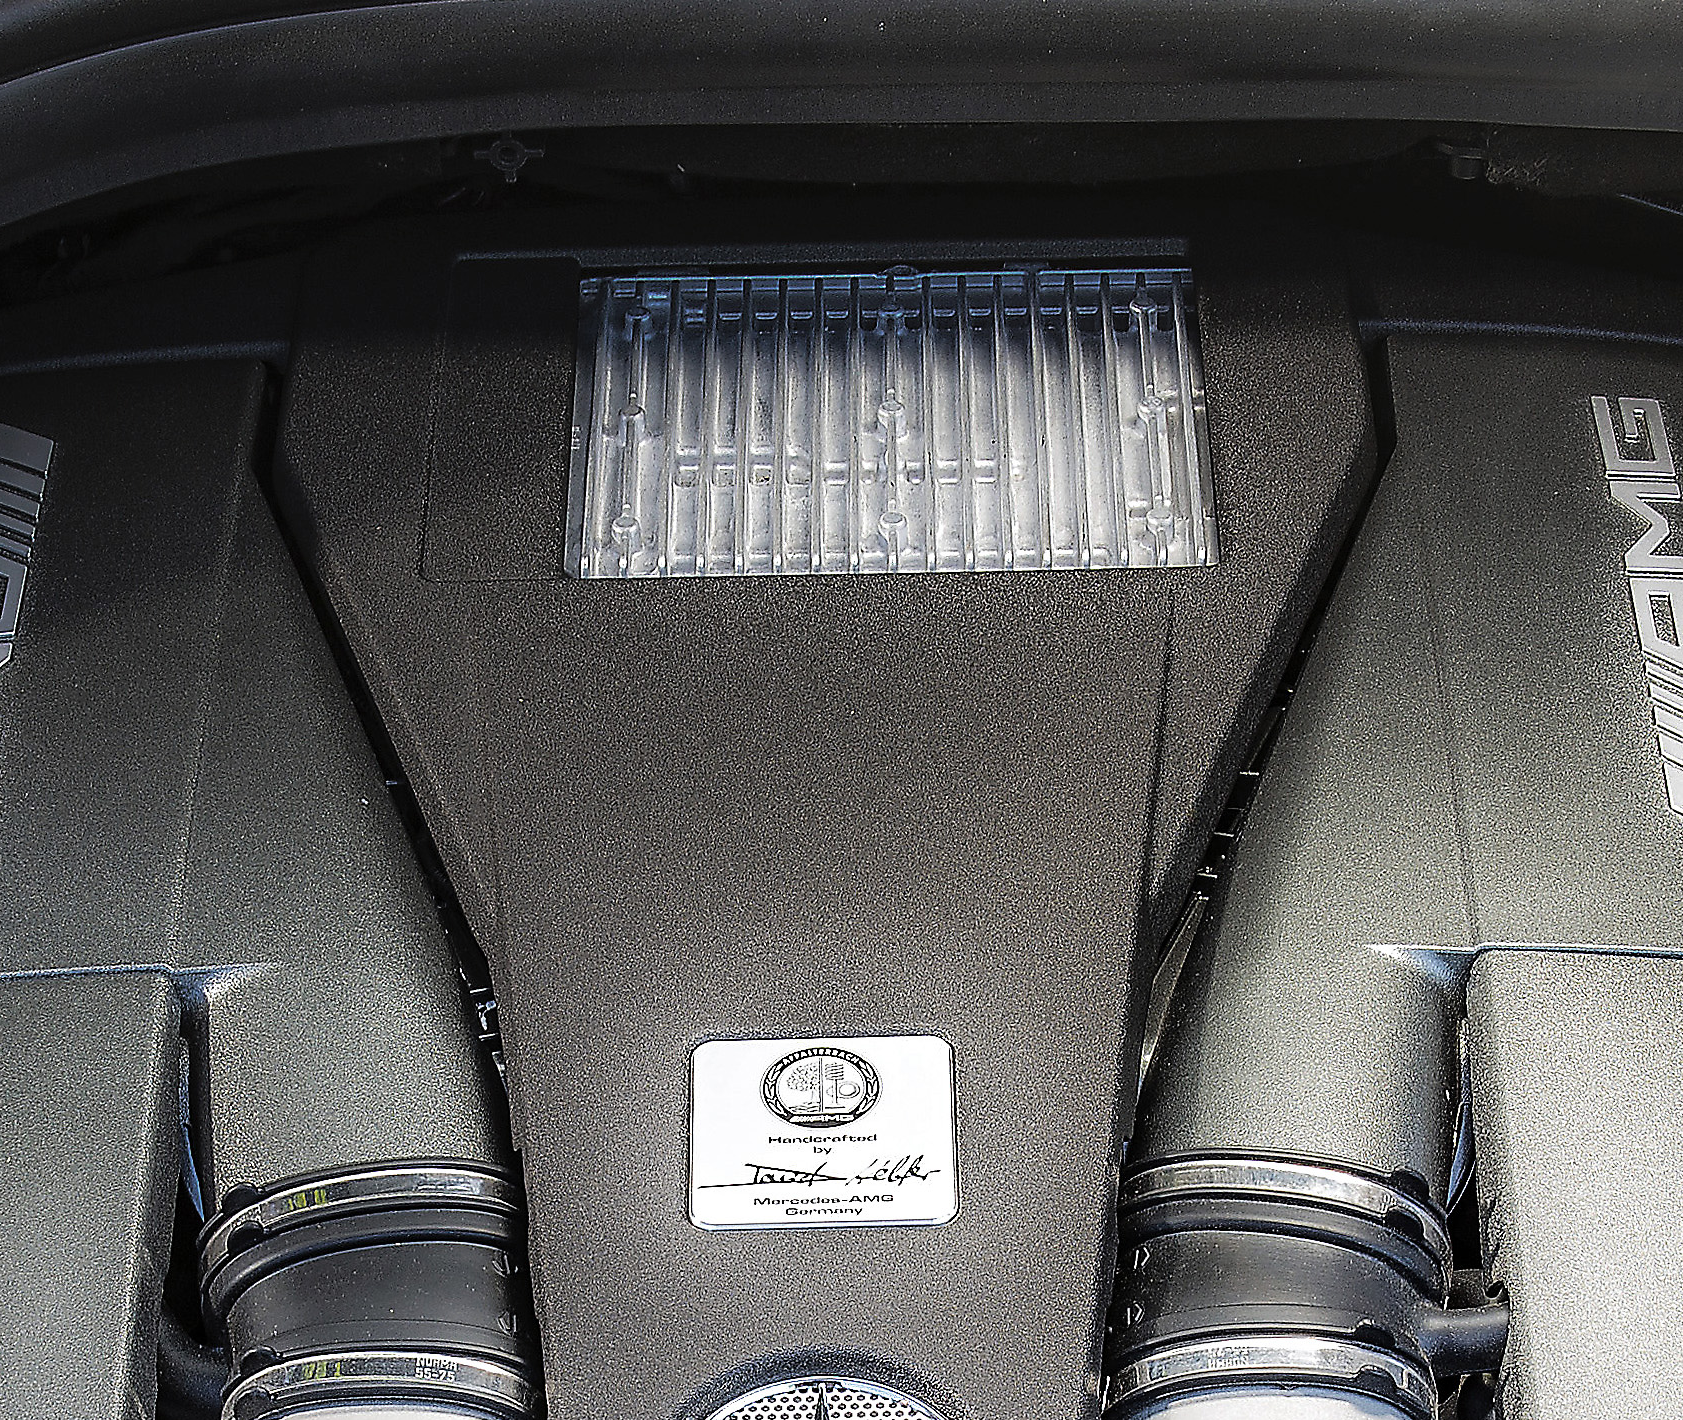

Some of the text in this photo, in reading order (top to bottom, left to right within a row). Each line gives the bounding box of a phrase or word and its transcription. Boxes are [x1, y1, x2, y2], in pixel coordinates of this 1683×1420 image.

[813, 1146, 832, 1155] by
[753, 1194, 894, 1206] Mercedes-AMG
[785, 1207, 863, 1217] Germany
